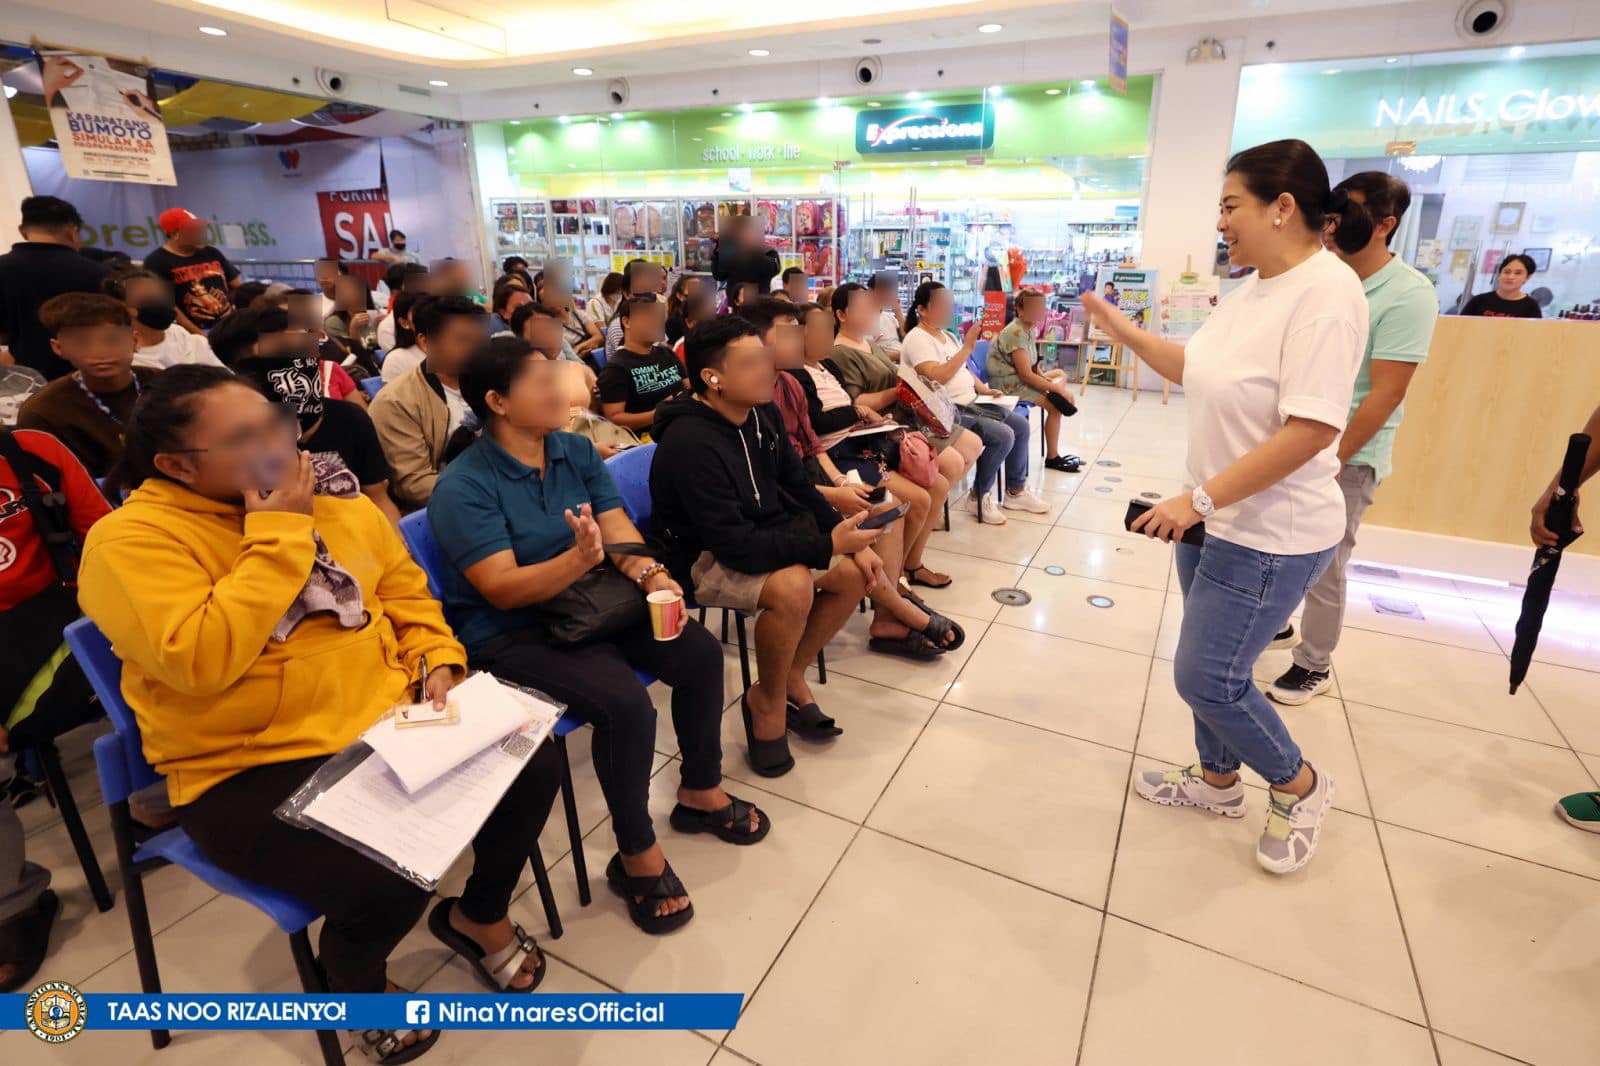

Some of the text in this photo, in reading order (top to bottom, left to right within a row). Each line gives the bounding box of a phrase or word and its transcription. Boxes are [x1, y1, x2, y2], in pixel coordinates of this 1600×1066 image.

[69, 119, 152, 140] BUMOTO
[866, 115, 983, 147] Expressions
[72, 132, 154, 150] SIMULAN SA
[702, 144, 740, 161] school
[749, 144, 776, 160] work
[631, 364, 659, 375] TOMMY
